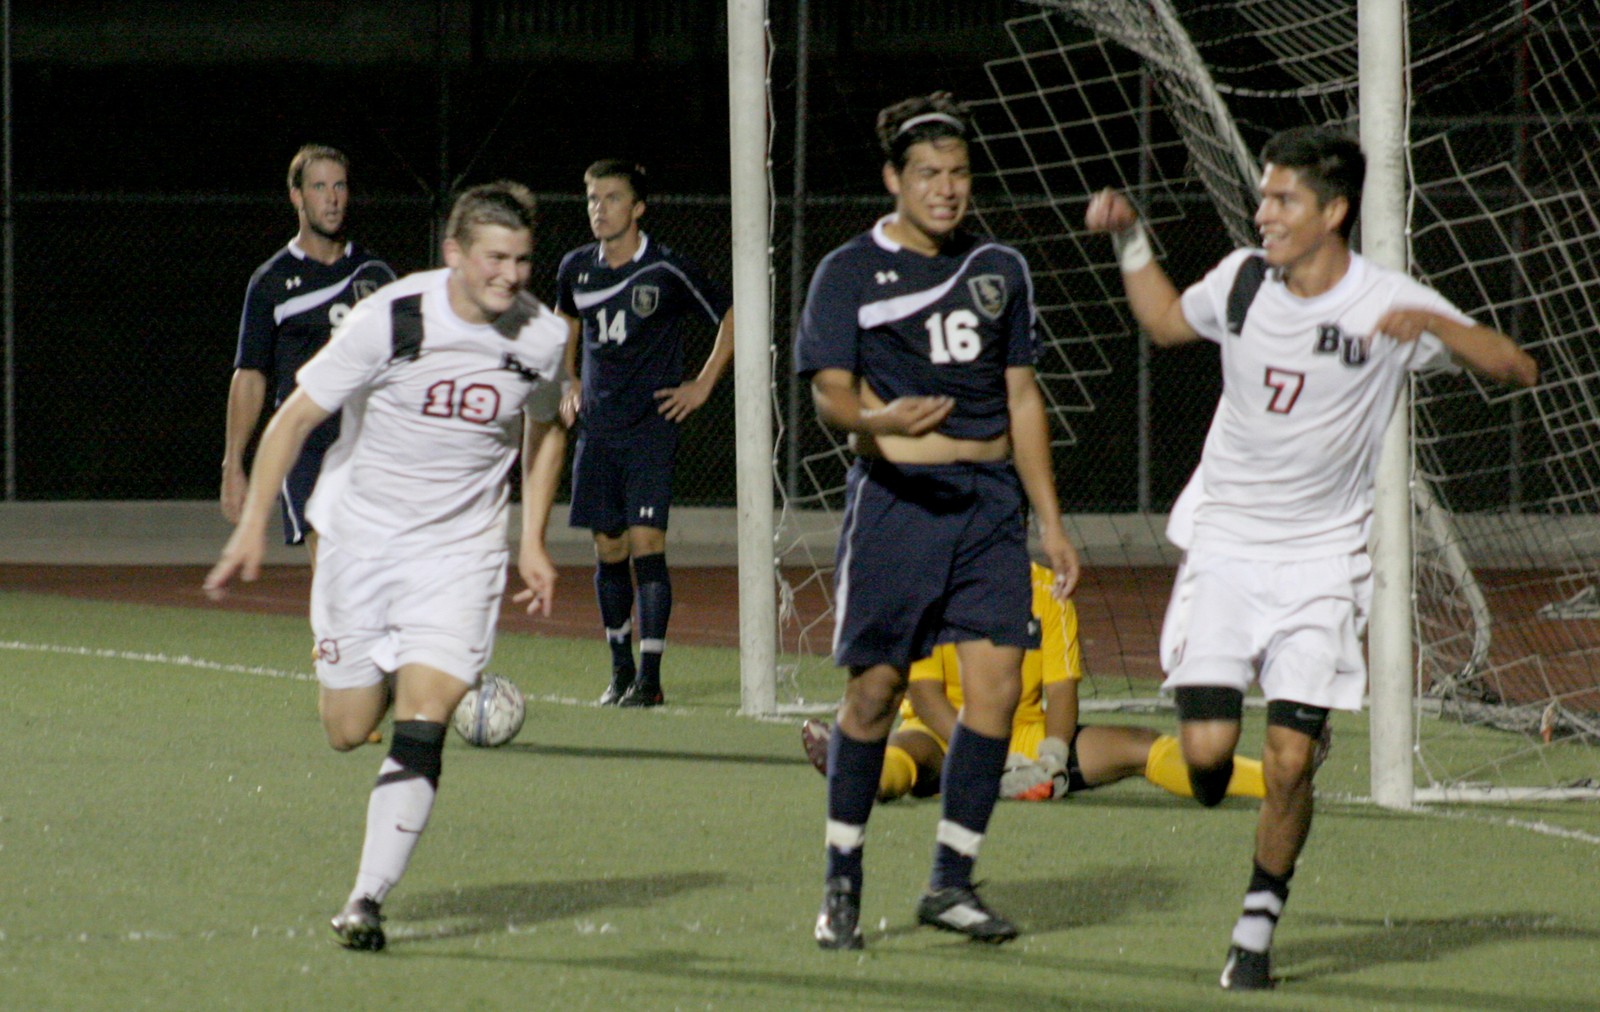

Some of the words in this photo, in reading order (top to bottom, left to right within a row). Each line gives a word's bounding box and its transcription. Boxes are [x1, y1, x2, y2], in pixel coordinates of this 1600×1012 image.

[596, 308, 627, 346] 14
[925, 309, 981, 364] 16
[1313, 323, 1370, 367] BU
[423, 379, 500, 424] 19
[1264, 366, 1305, 414] 7
